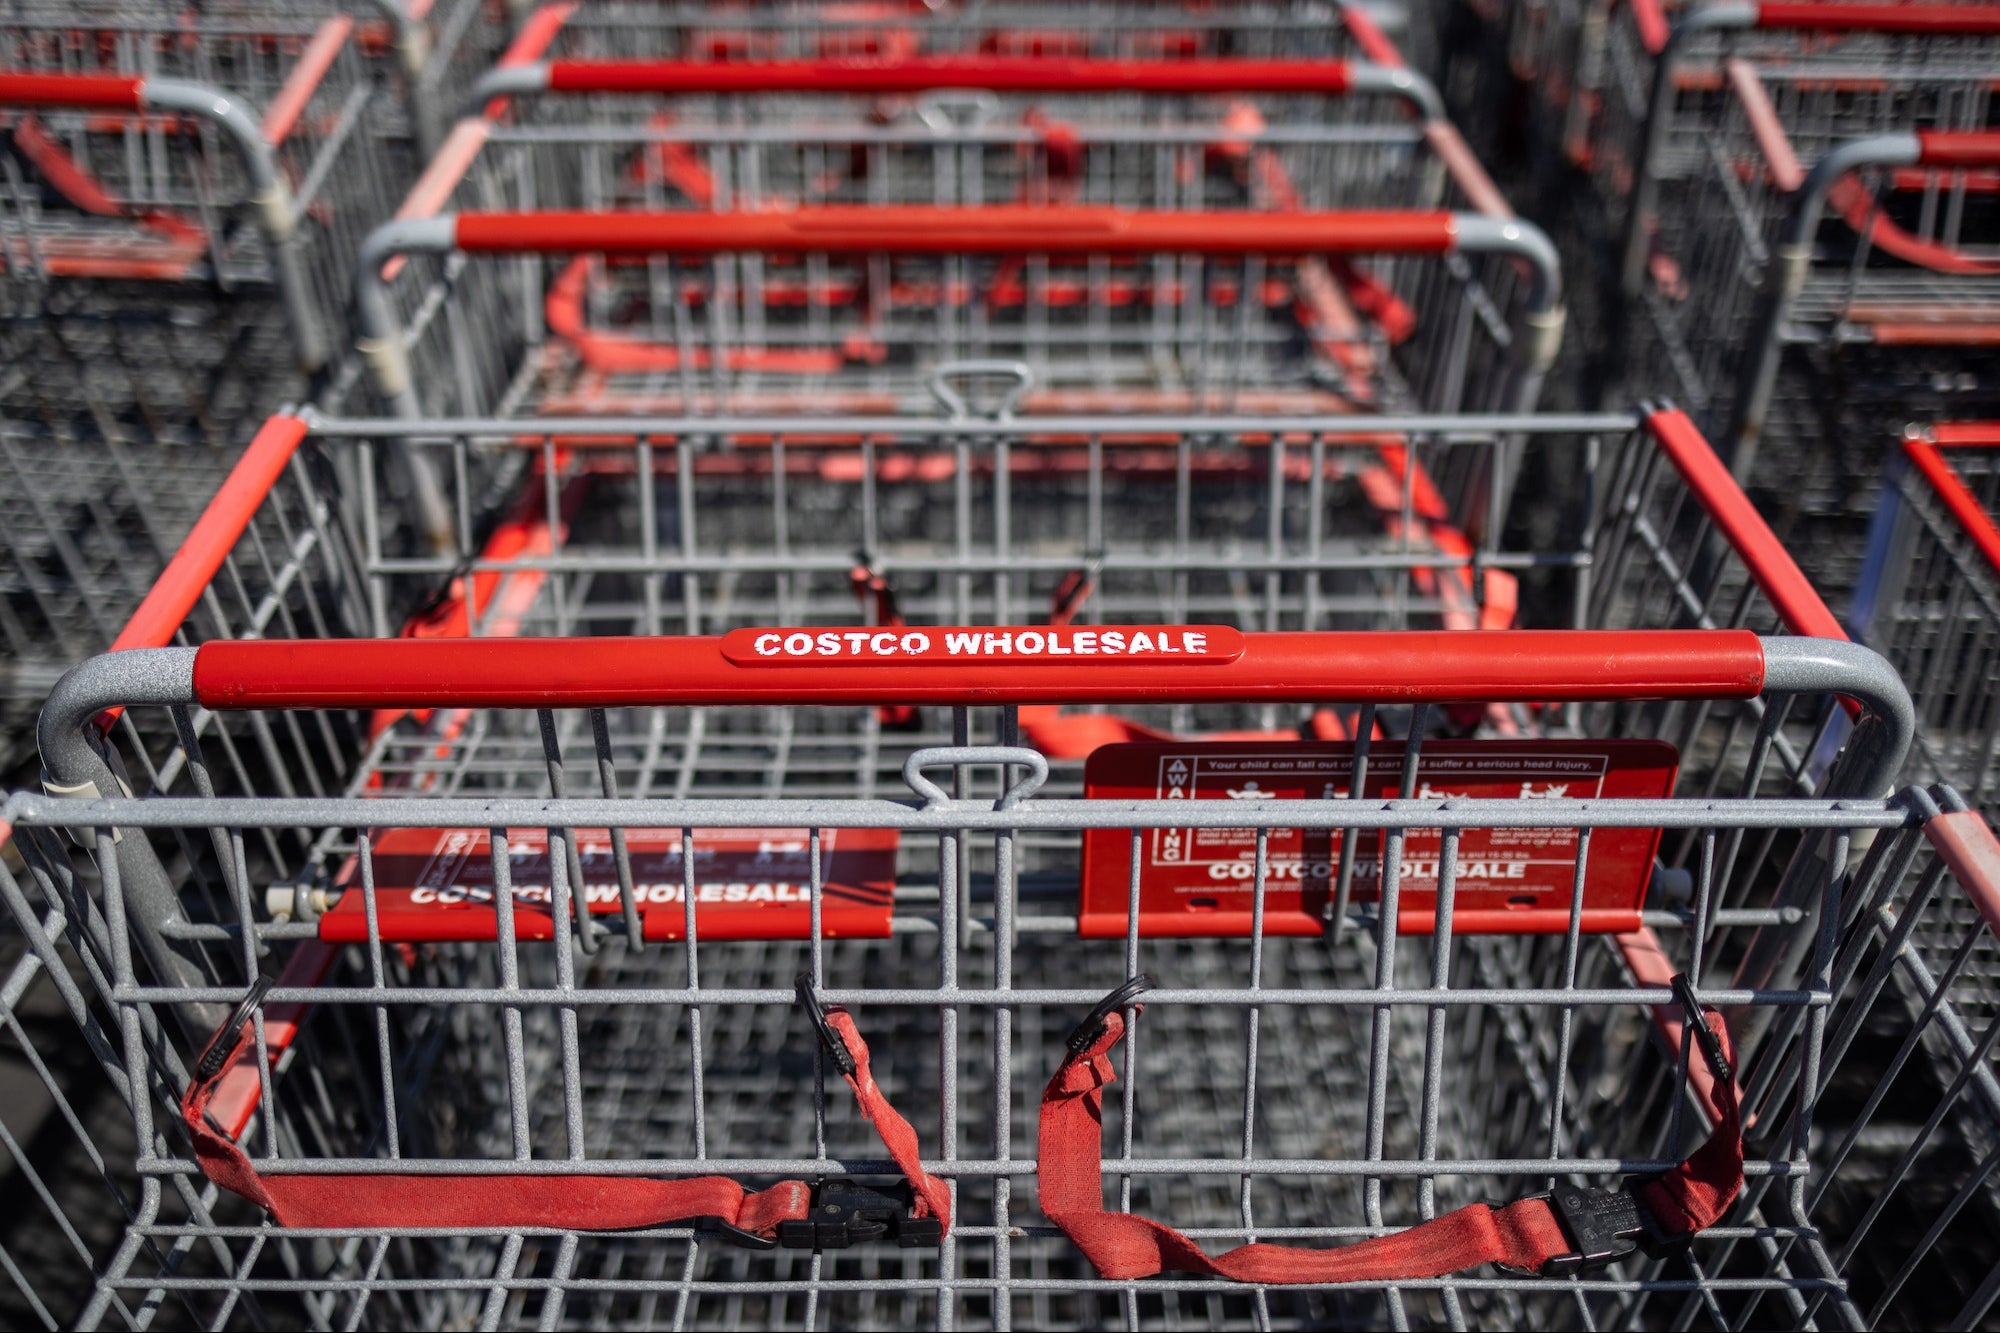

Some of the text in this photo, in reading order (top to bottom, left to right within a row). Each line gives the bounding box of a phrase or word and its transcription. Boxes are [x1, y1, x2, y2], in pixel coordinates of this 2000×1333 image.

[754, 631, 1207, 656] COSTCO WHOLESALE
[1208, 761, 1236, 769] Your
[1240, 761, 1269, 769] child
[1429, 760, 1463, 768] suffer
[1162, 773, 1188, 861] WAING
[1208, 862, 1331, 879] COTCO
